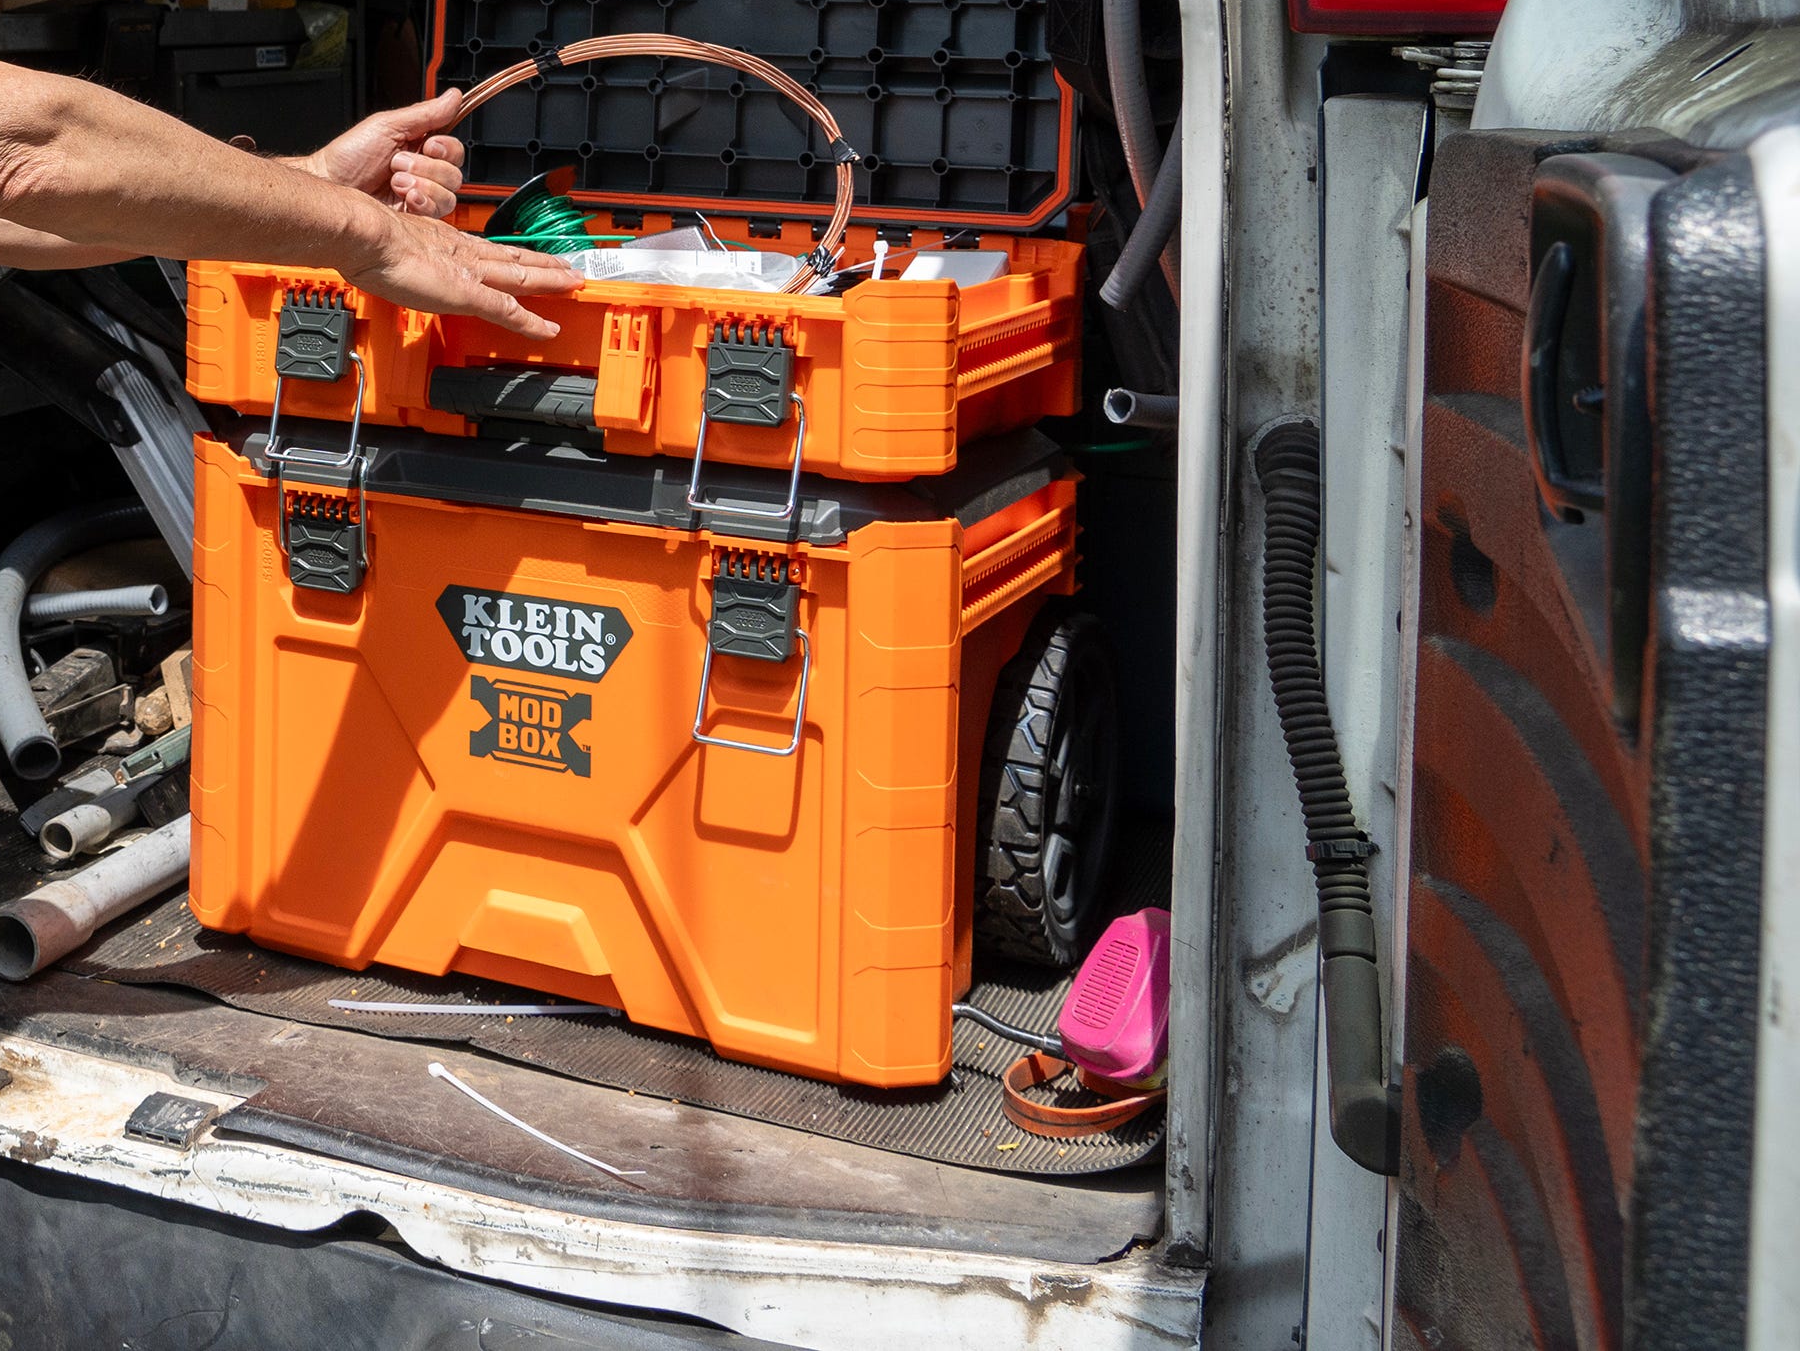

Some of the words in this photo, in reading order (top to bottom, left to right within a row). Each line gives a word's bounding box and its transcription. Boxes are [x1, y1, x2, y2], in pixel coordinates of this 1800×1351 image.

[462, 594, 605, 643] KLEIN
[461, 625, 606, 675] TOOLS
[498, 692, 562, 729] MOD
[498, 721, 562, 759] BOX
